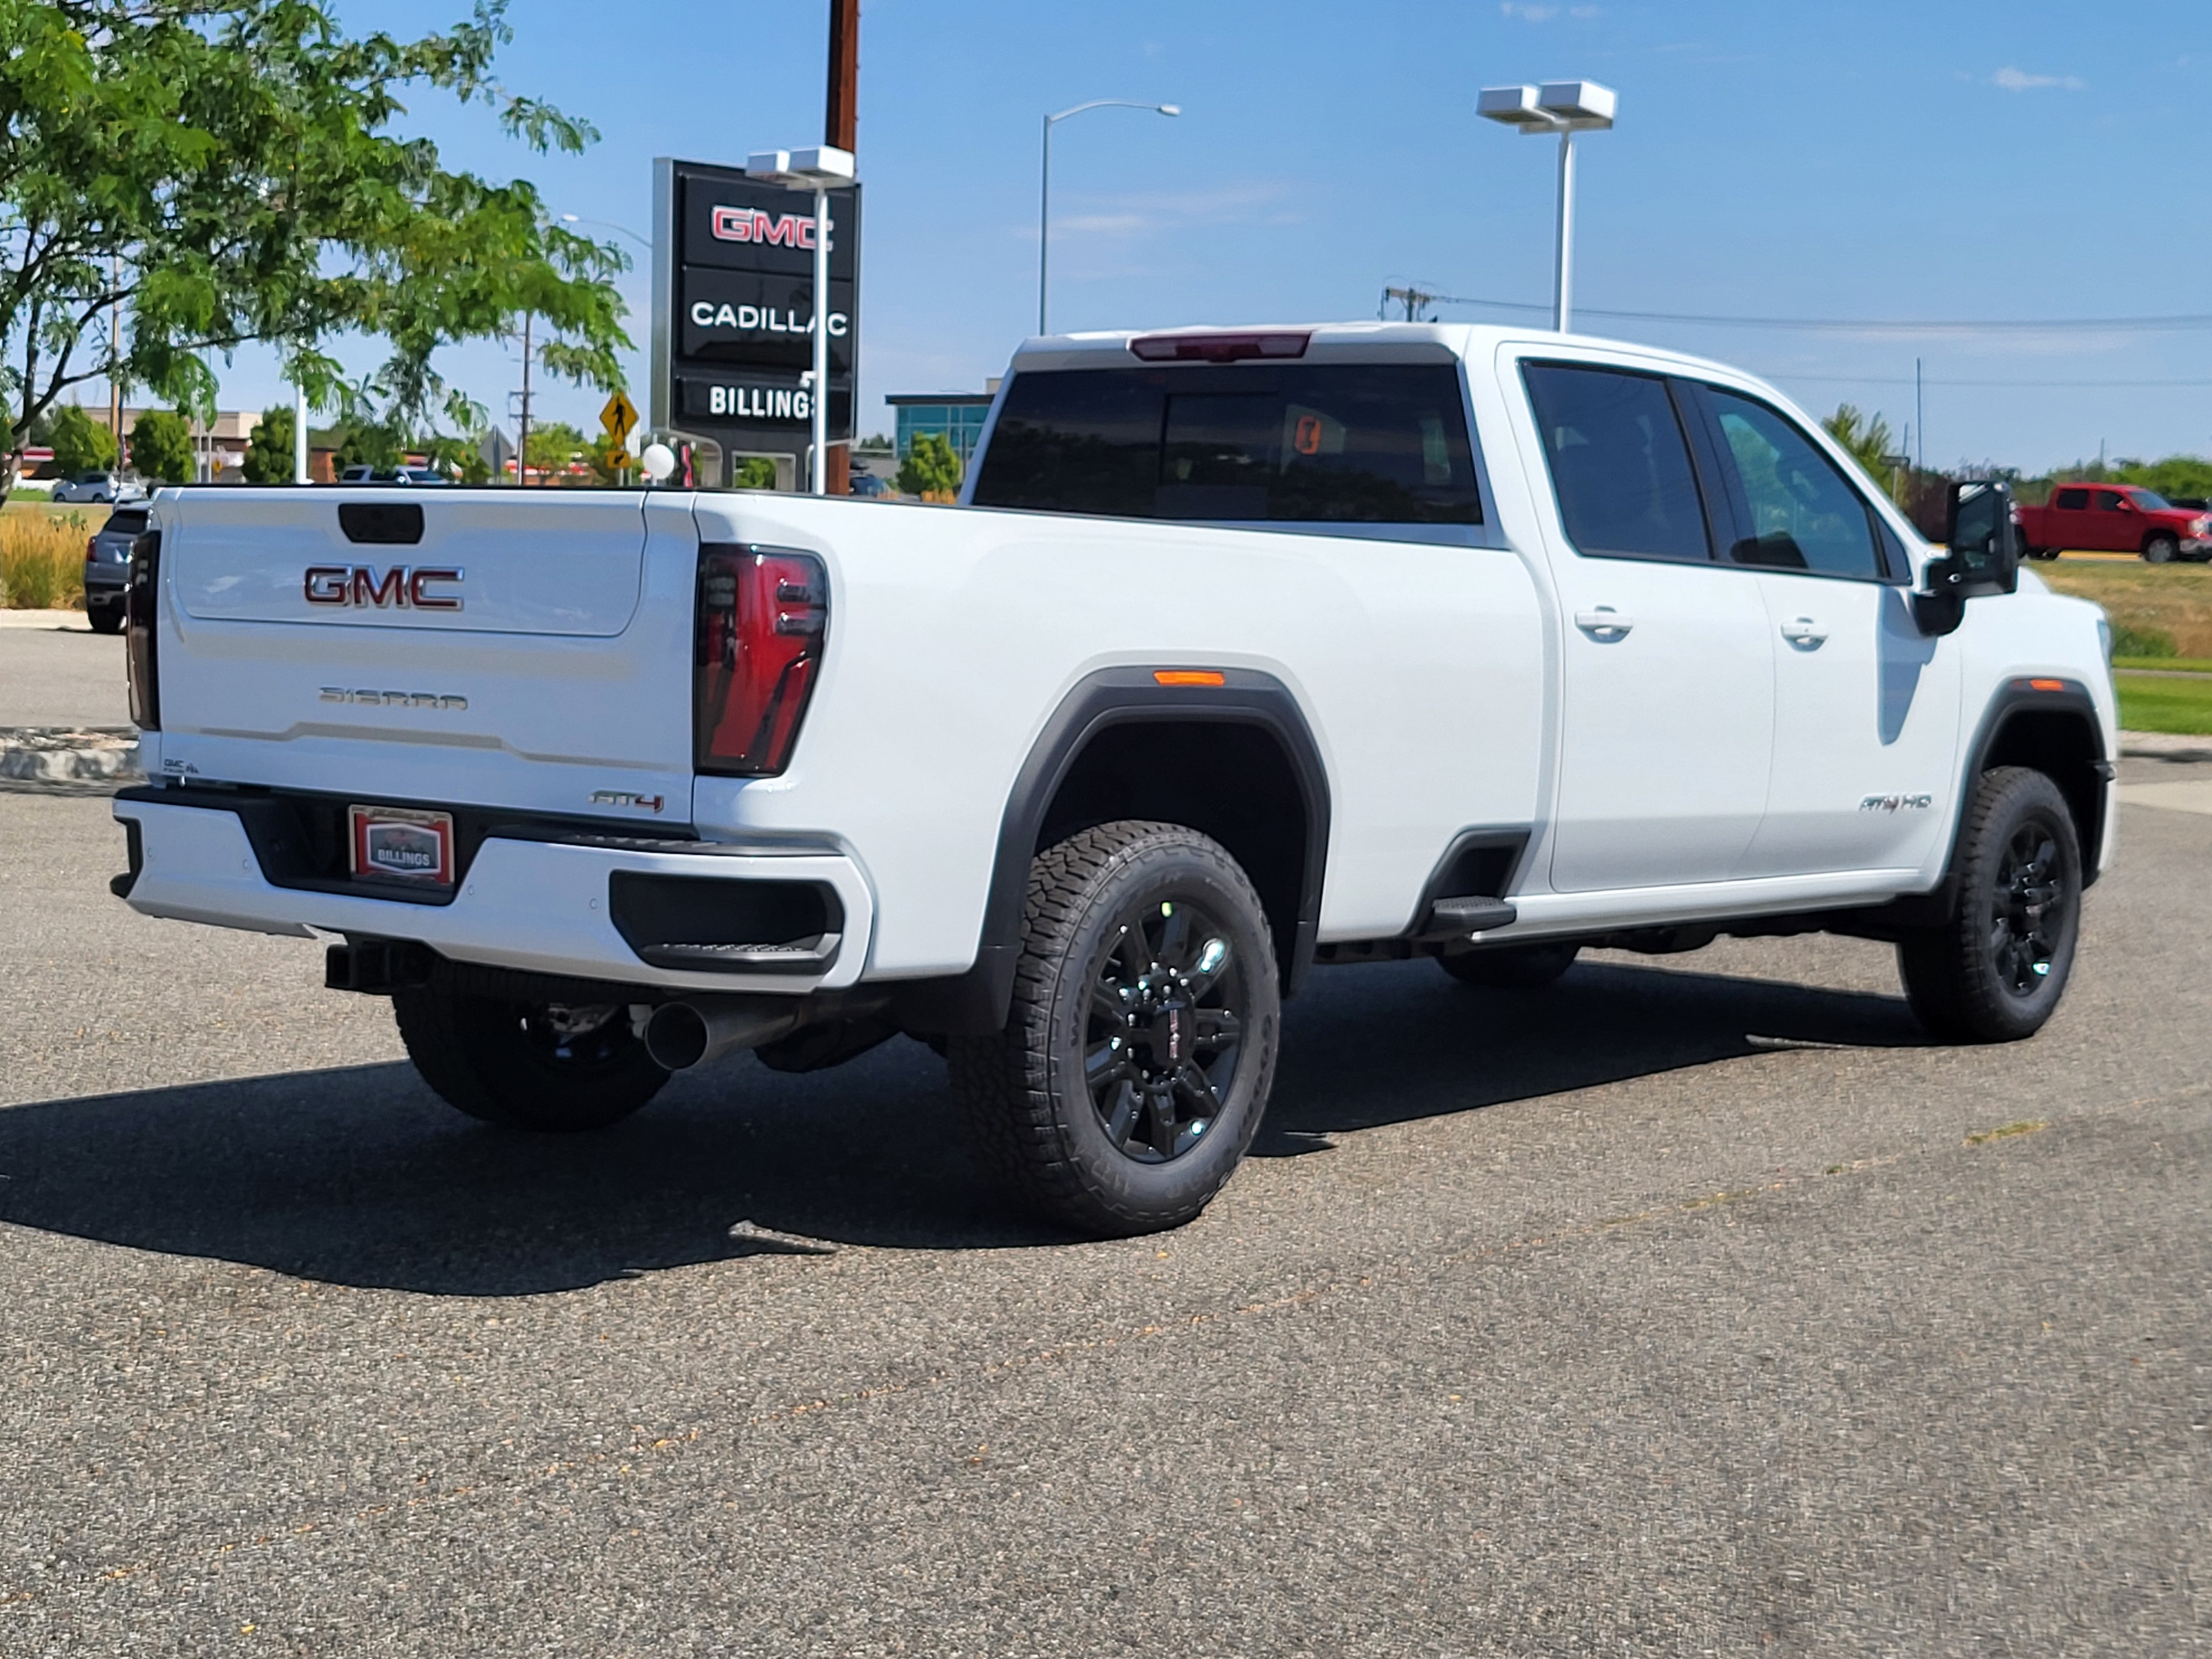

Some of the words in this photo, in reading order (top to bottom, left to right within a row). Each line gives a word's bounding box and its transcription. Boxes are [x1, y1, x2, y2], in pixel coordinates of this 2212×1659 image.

[712, 205, 834, 252] GMC
[709, 386, 816, 420] BILLING
[305, 563, 465, 612] GMC
[319, 687, 468, 711] SIERRA
[588, 790, 665, 813] AT4
[378, 848, 430, 867] BILLINGS
